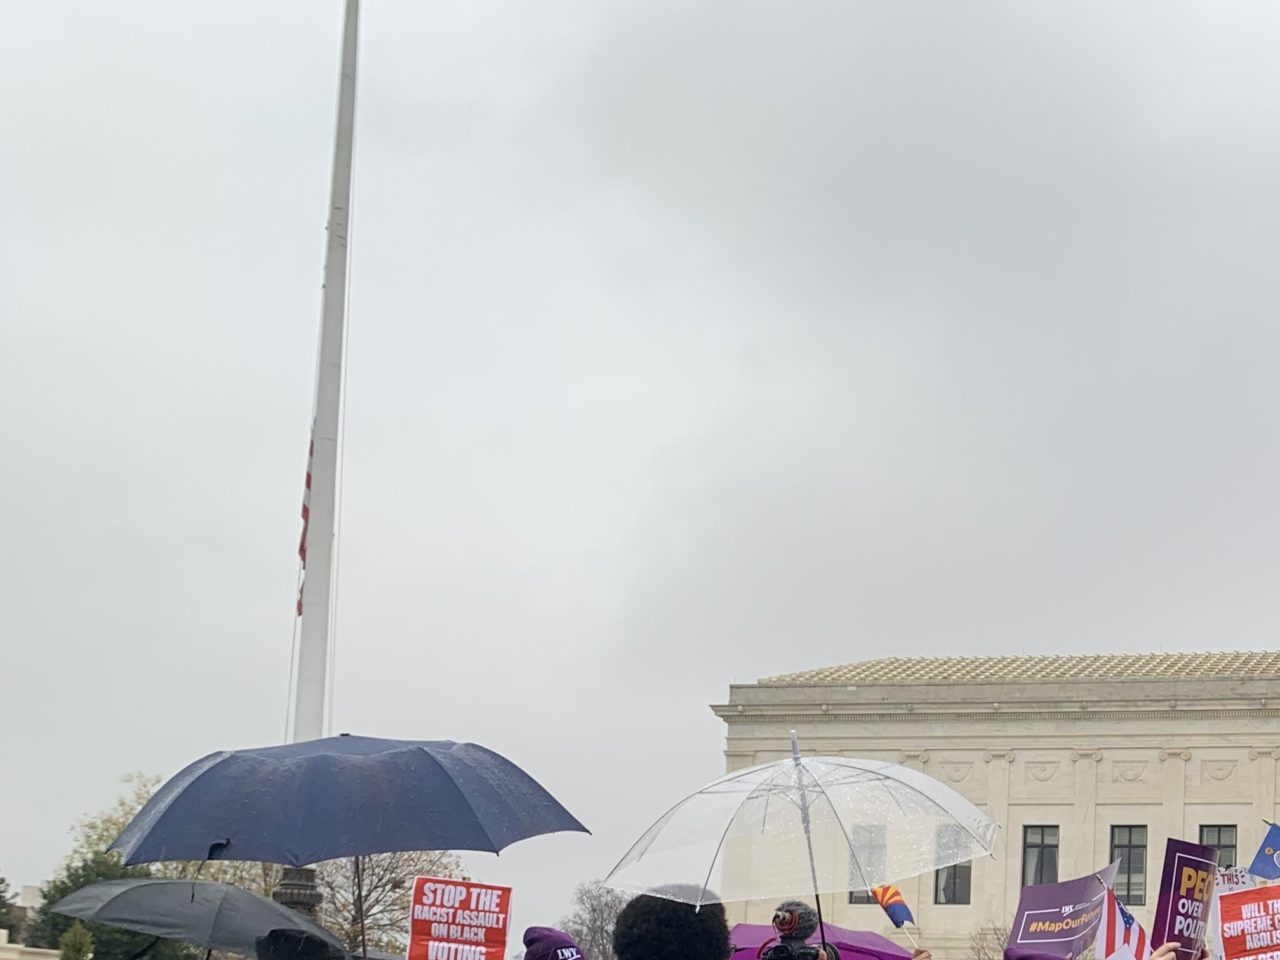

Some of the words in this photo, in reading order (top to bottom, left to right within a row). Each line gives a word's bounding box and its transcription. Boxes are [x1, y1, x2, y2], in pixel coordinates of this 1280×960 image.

[1180, 867, 1215, 902] PEO
[1220, 873, 1241, 886] THIS
[423, 882, 467, 908] STOP
[470, 887, 502, 912] THE
[414, 905, 455, 924] RACIST
[455, 910, 505, 928] ASSAULT
[1242, 901, 1266, 919] WILL
[431, 923, 448, 938] ON
[450, 925, 486, 942] BLACK
[1174, 916, 1206, 939] POLIT
[1223, 916, 1274, 938] SUPREME
